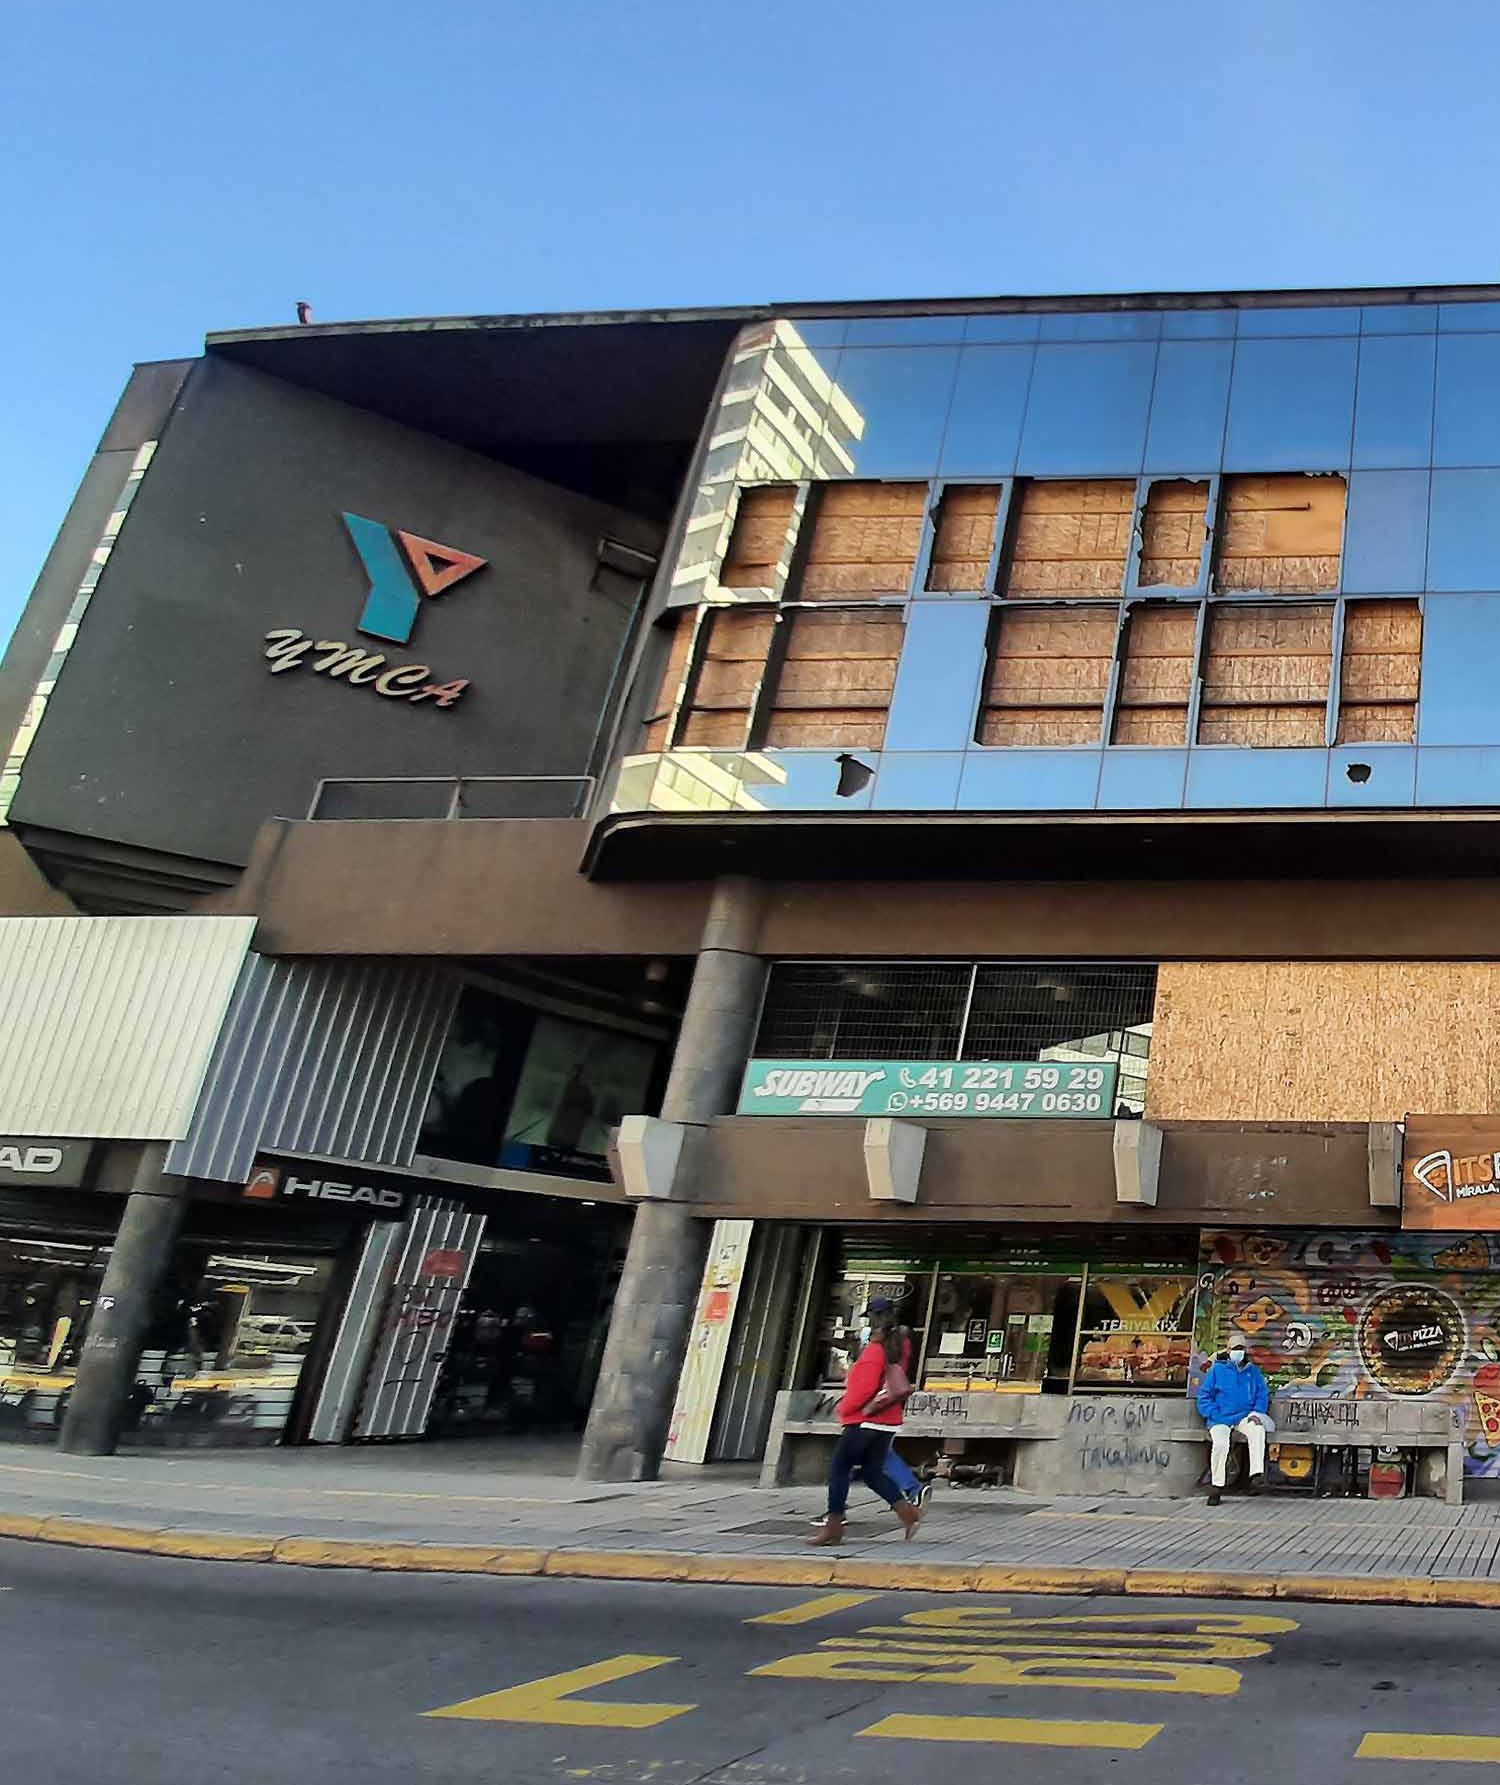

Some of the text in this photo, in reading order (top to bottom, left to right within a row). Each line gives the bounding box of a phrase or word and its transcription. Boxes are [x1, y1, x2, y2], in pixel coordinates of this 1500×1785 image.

[264, 628, 471, 708] YMCA
[753, 1067, 1104, 1097] SUBWAY 41 221 59 29
[910, 1093, 1101, 1112] +569 9447 0630
[283, 1176, 403, 1208] HEAD
